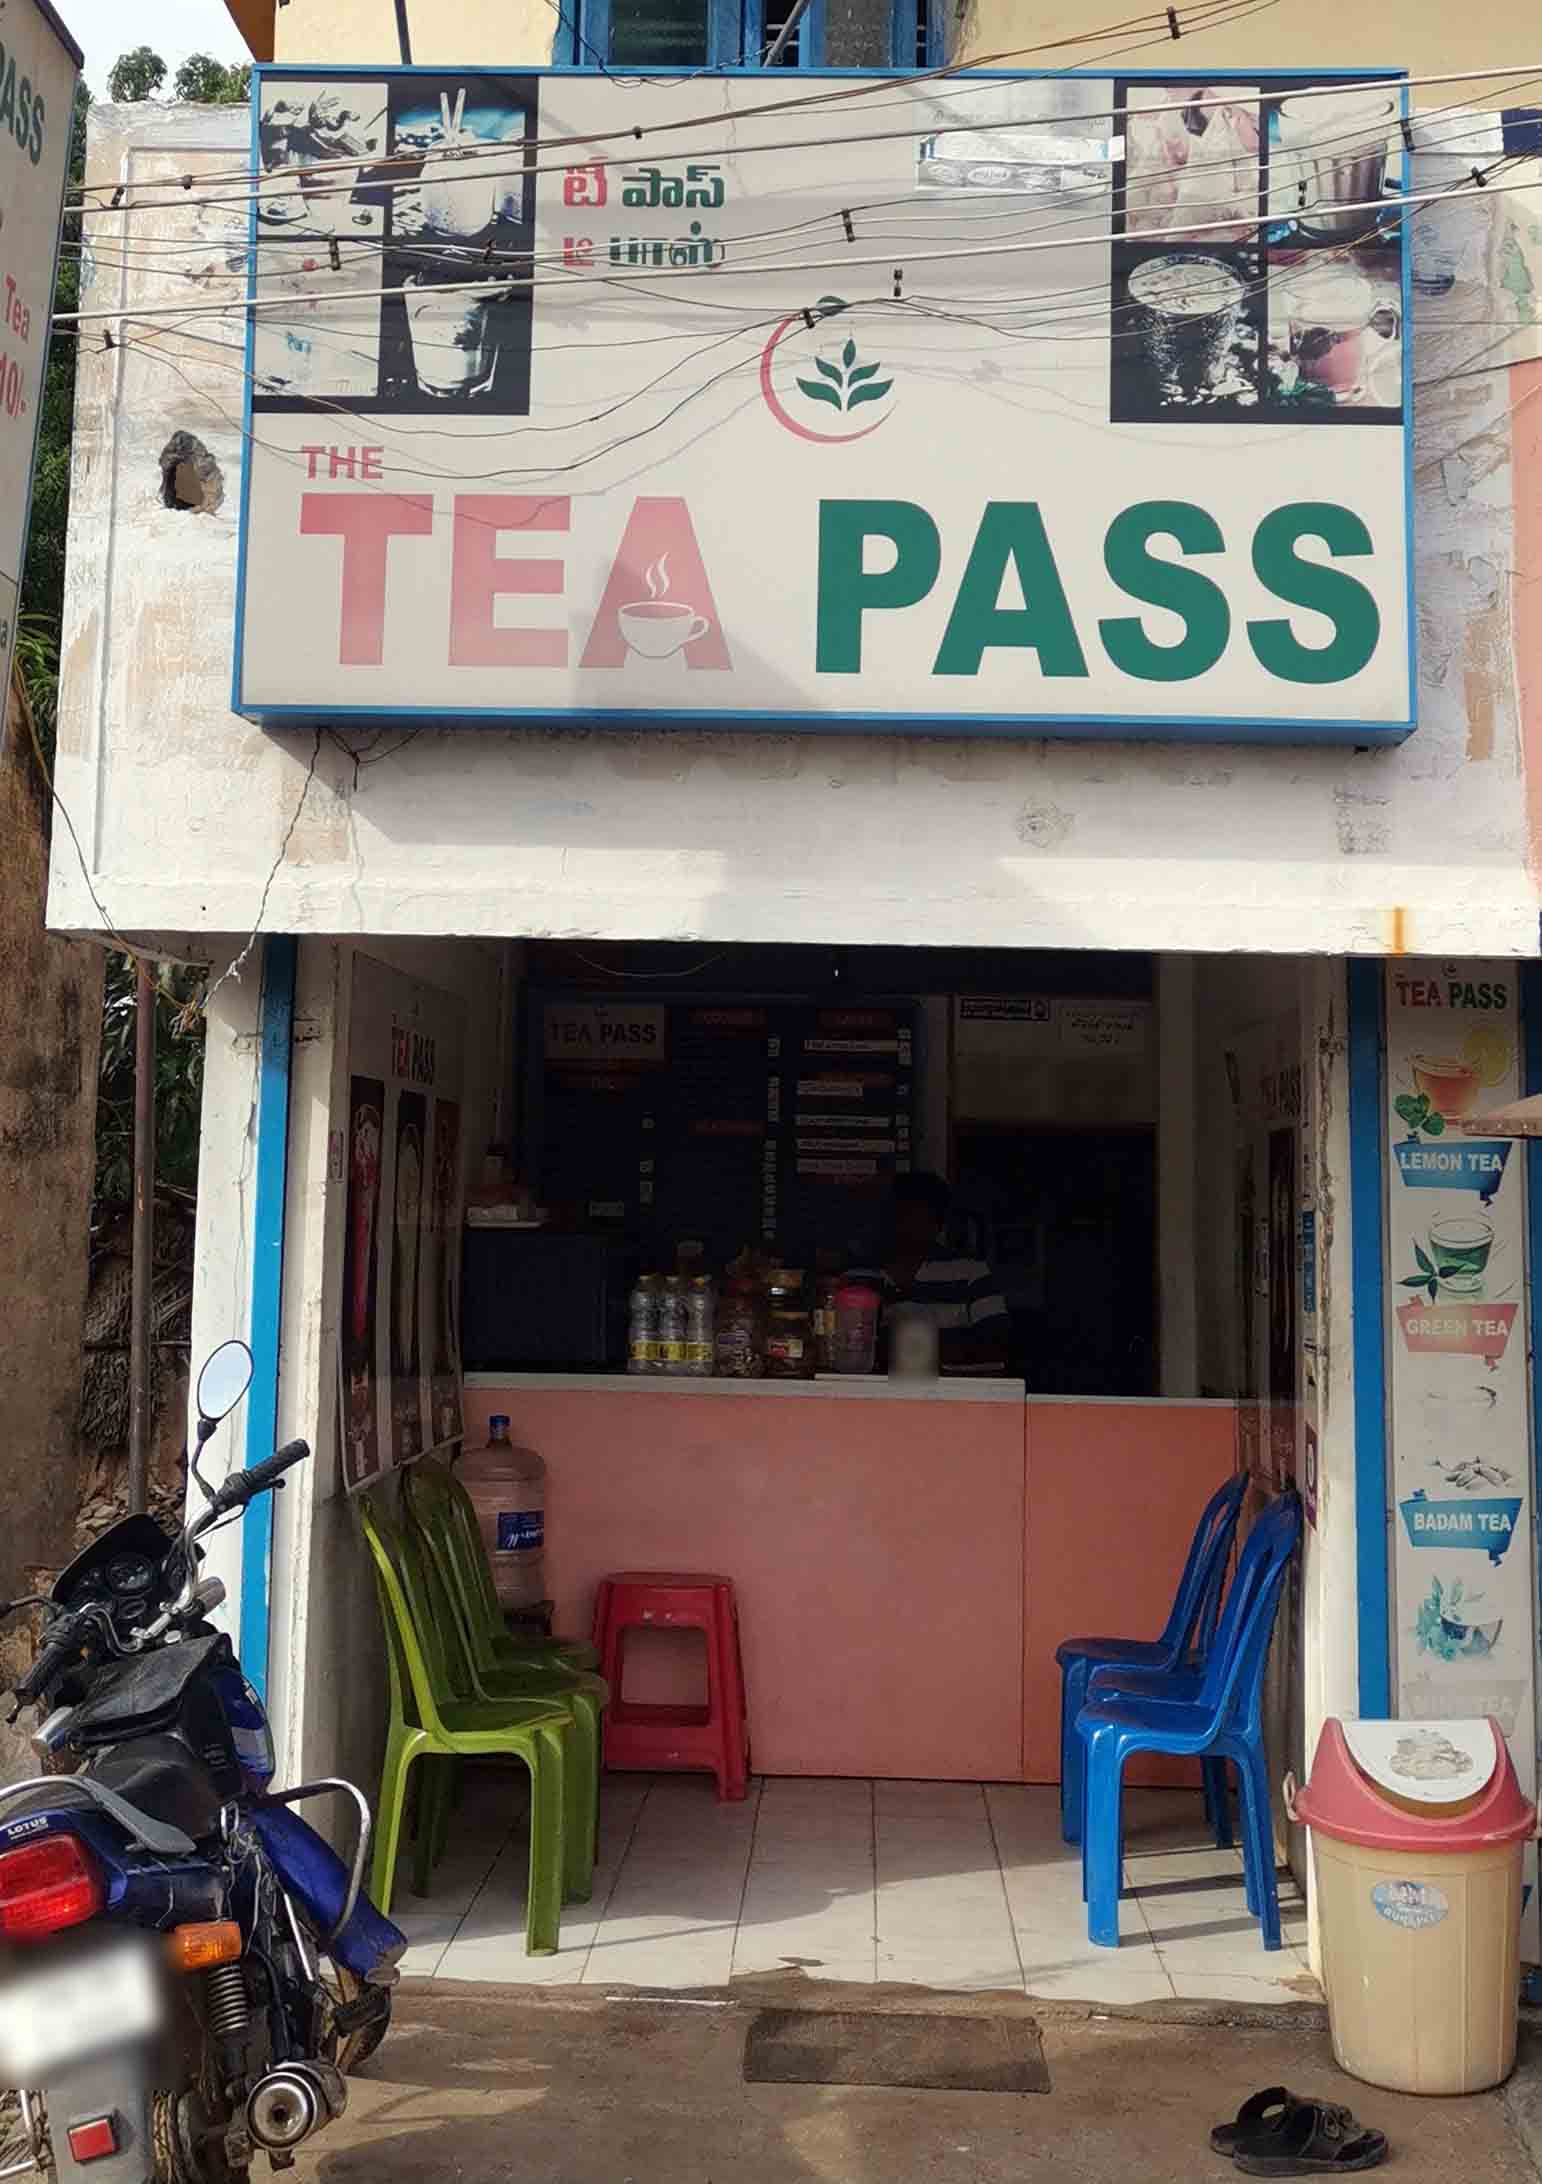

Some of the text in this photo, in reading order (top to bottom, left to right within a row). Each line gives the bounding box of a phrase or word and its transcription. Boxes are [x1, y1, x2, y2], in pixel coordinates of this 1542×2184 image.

[0, 42, 45, 166] ASS
[622, 164, 725, 208] పాస్
[4, 273, 31, 344] Tea
[301, 445, 383, 481] THE
[300, 493, 1381, 685] TEA PASS
[1394, 980, 1507, 1010] TEA PASS
[600, 1022, 657, 1047] PASS
[1400, 1151, 1503, 1172] LEMON TEA
[1406, 1319, 1508, 1337] GREEN TEA
[1413, 1512, 1512, 1532] BADAM TEA
[7, 1815, 48, 1836] LOTUS
